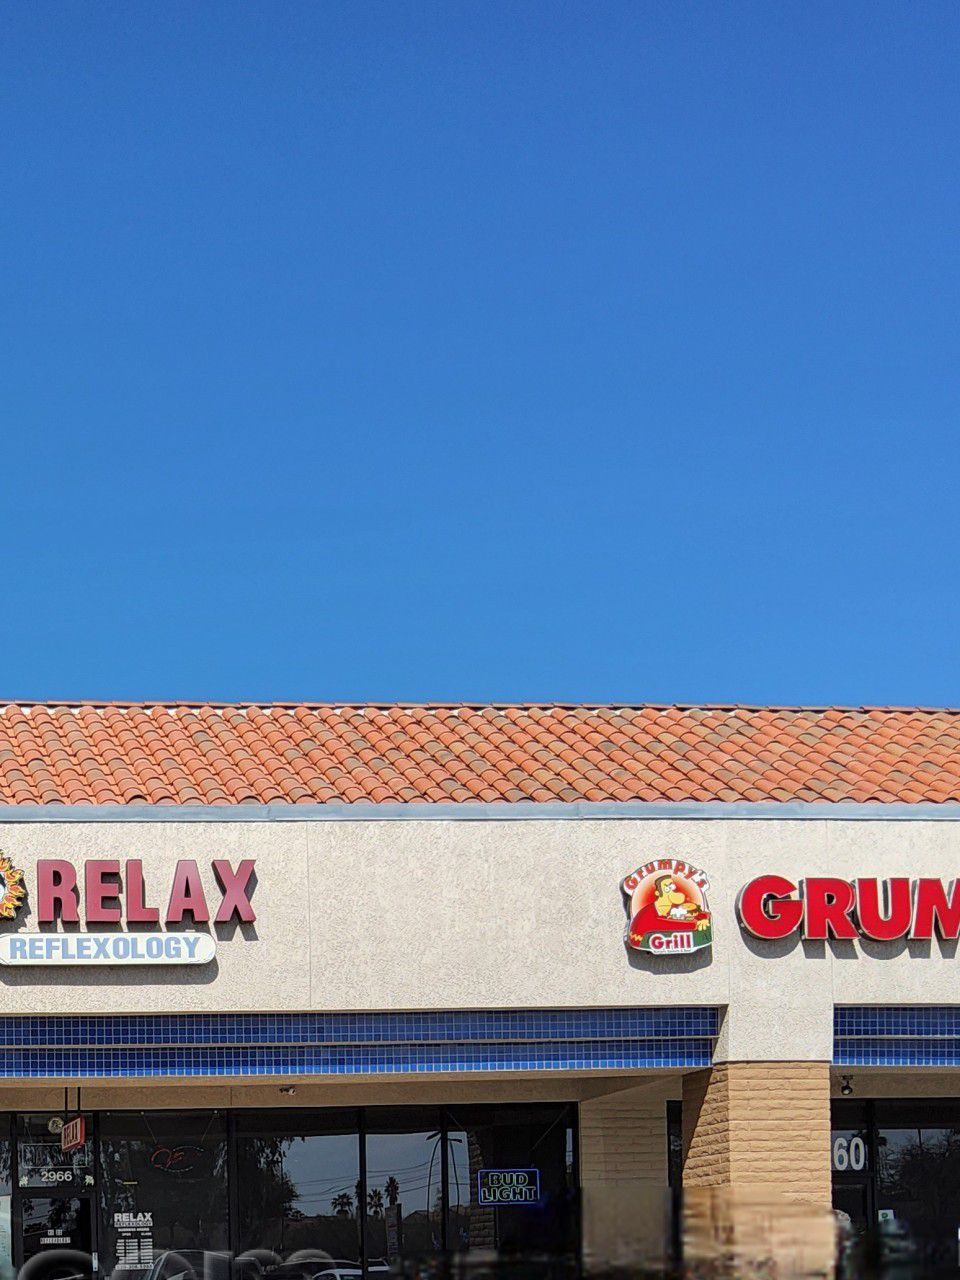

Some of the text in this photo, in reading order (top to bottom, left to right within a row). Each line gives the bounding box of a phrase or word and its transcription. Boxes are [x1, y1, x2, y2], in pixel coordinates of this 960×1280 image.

[37, 859, 257, 924] RELAX
[740, 874, 960, 940] GRUM
[9, 936, 201, 960] REFLEXOLOGY
[651, 934, 691, 950] Grill
[833, 1137, 865, 1171] 60
[41, 1171, 73, 1181] 2966
[489, 1172, 528, 1186] BUD
[481, 1186, 537, 1202] LIGHT
[114, 1212, 152, 1221] RELAX
